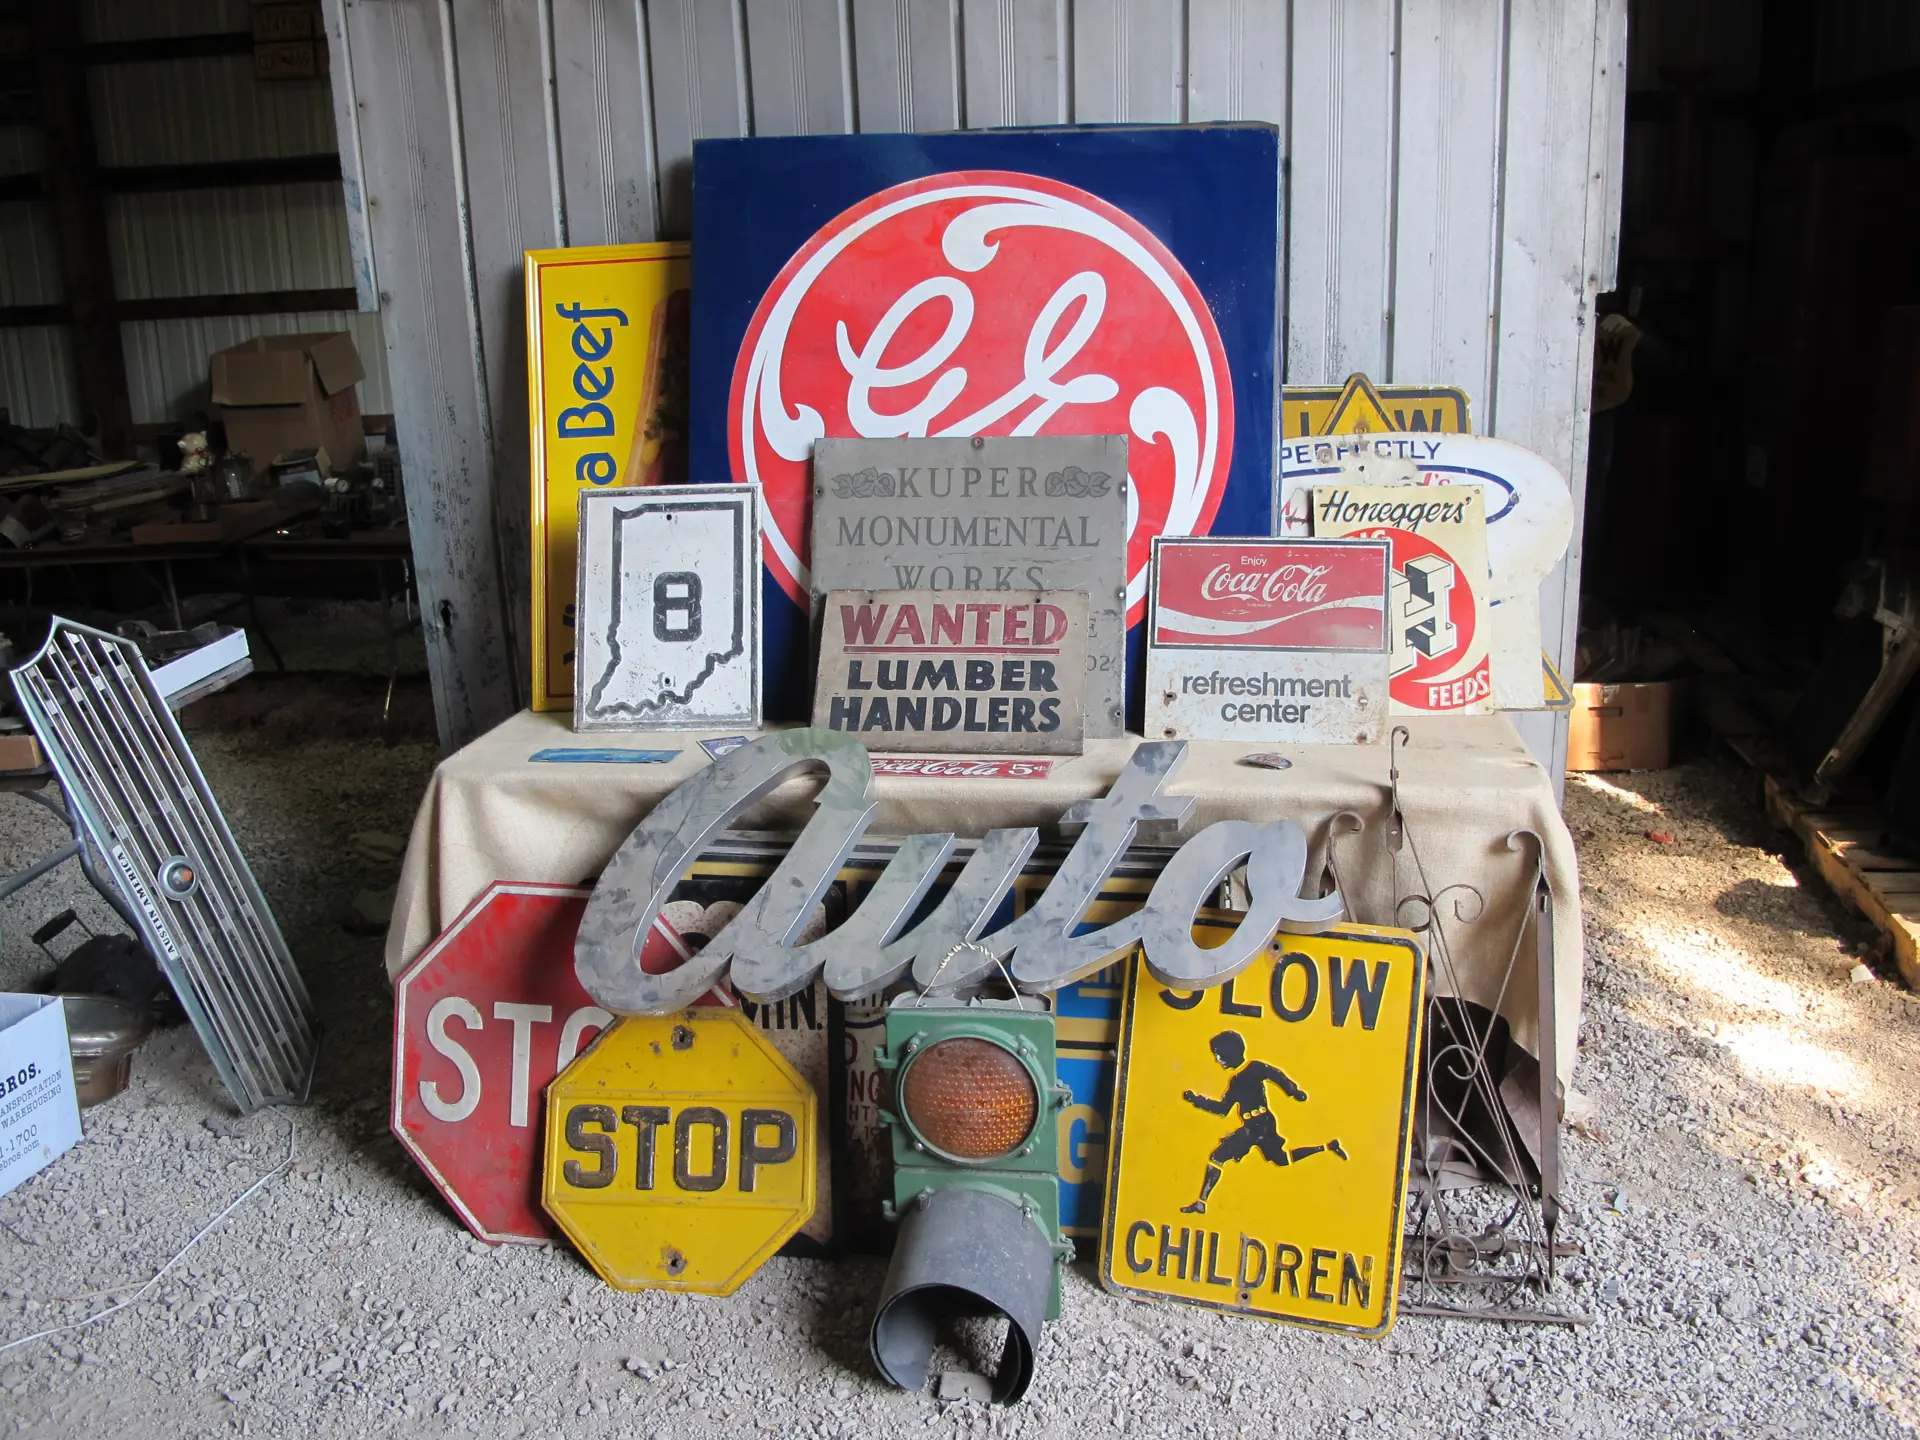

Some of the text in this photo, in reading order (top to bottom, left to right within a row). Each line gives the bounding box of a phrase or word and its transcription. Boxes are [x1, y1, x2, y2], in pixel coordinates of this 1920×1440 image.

[556, 302, 629, 438] Beef
[1282, 440, 1442, 464] PERFCTLY
[899, 467, 1038, 499] KUPER
[836, 516, 1100, 547] MONUMENTAL
[893, 565, 1044, 591] WORKS
[1241, 556, 1267, 566] Enjoy
[1201, 563, 1333, 603] Coca-Cola
[653, 571, 702, 643] 8
[840, 604, 1068, 646] WANTED
[847, 660, 1058, 692] LUMBER
[1182, 671, 1352, 698] refreshment
[1428, 670, 1489, 708] FEEDS
[827, 696, 1061, 733] HANDLERS
[1221, 699, 1310, 723] center
[574, 727, 1343, 1015] Auto
[117, 851, 176, 954] AUSTIN AMERICA
[0, 1084, 62, 1130] WAREHOUSING
[563, 1104, 797, 1192] STOP
[1125, 1220, 1373, 1311] CHILDREN
